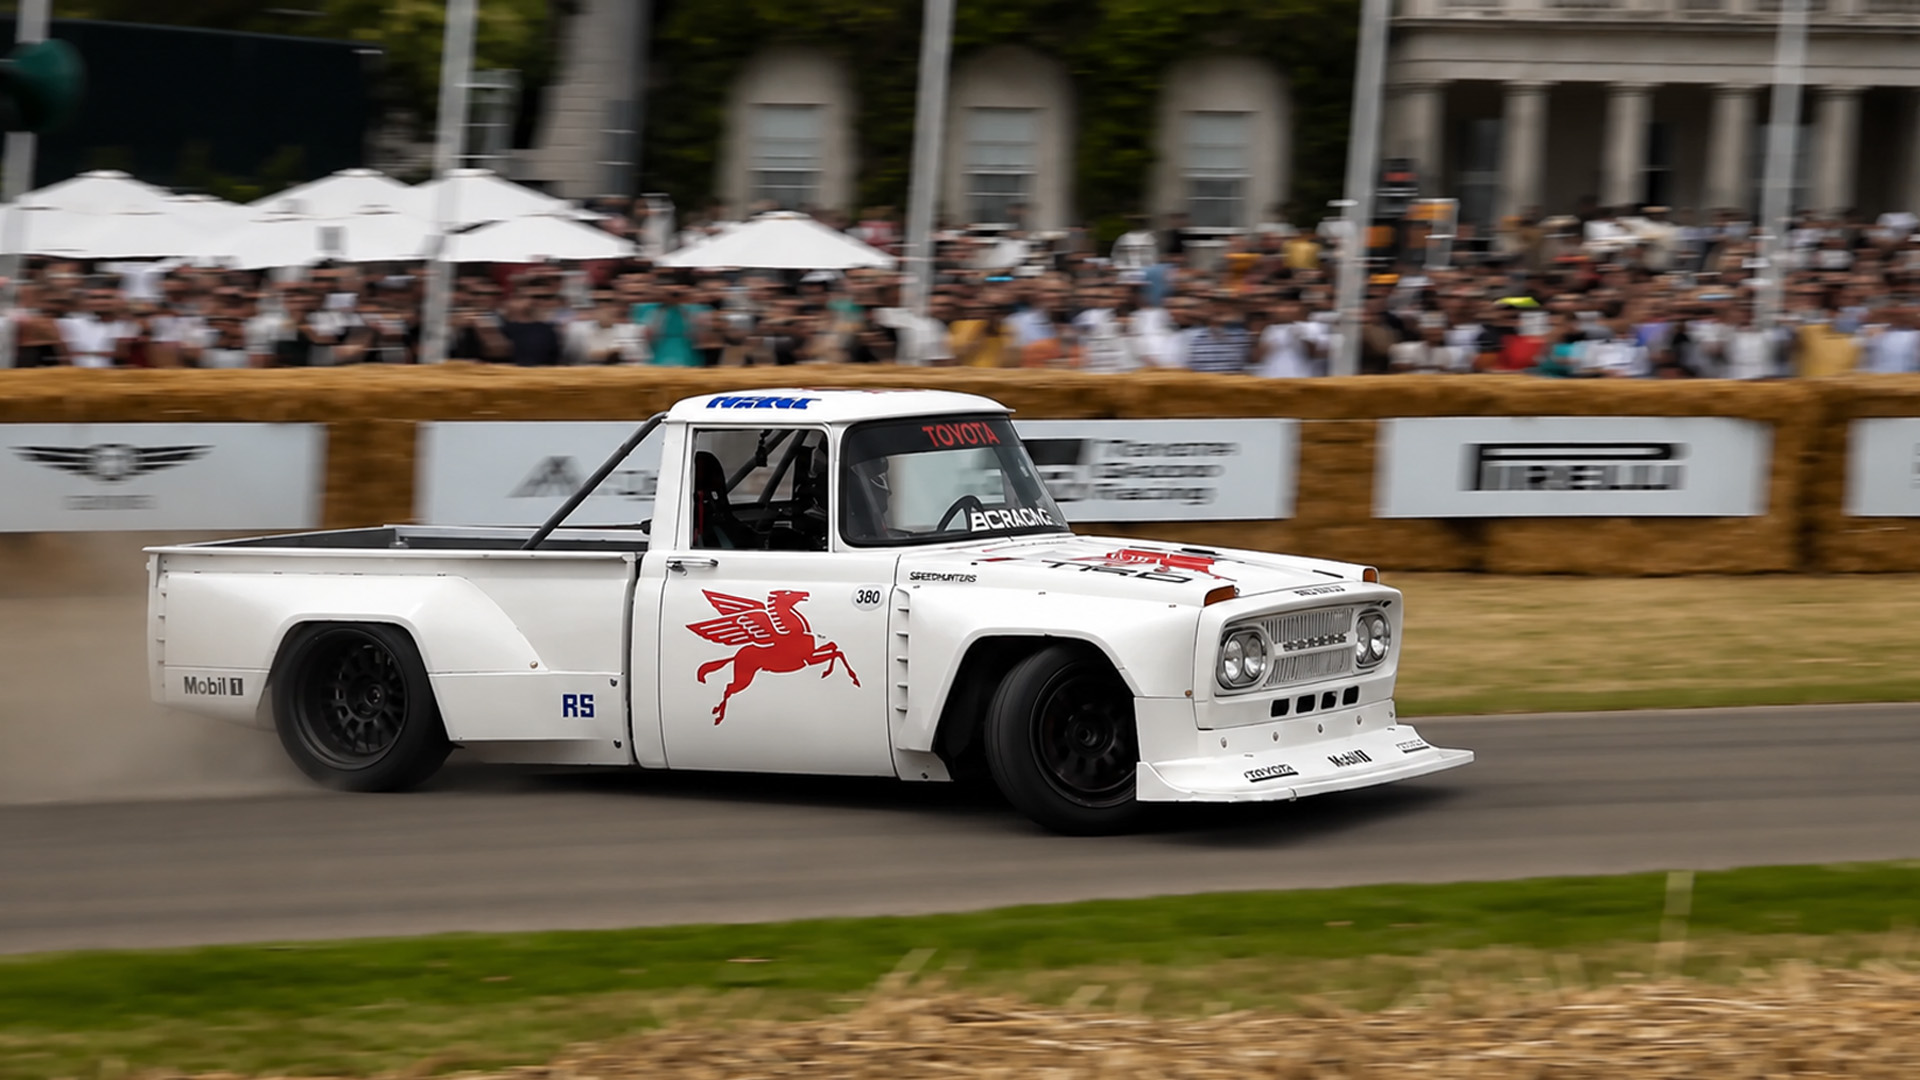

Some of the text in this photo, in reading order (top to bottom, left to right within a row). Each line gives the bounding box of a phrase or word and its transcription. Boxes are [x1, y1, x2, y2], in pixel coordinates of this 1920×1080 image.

[922, 422, 1000, 447] TOYOTA
[909, 571, 977, 583] SPEEDHUNTERS
[856, 589, 880, 604] 380
[184, 676, 243, 696] Mobil 1
[562, 694, 594, 718] RS
[1328, 751, 1361, 767] Mobil
